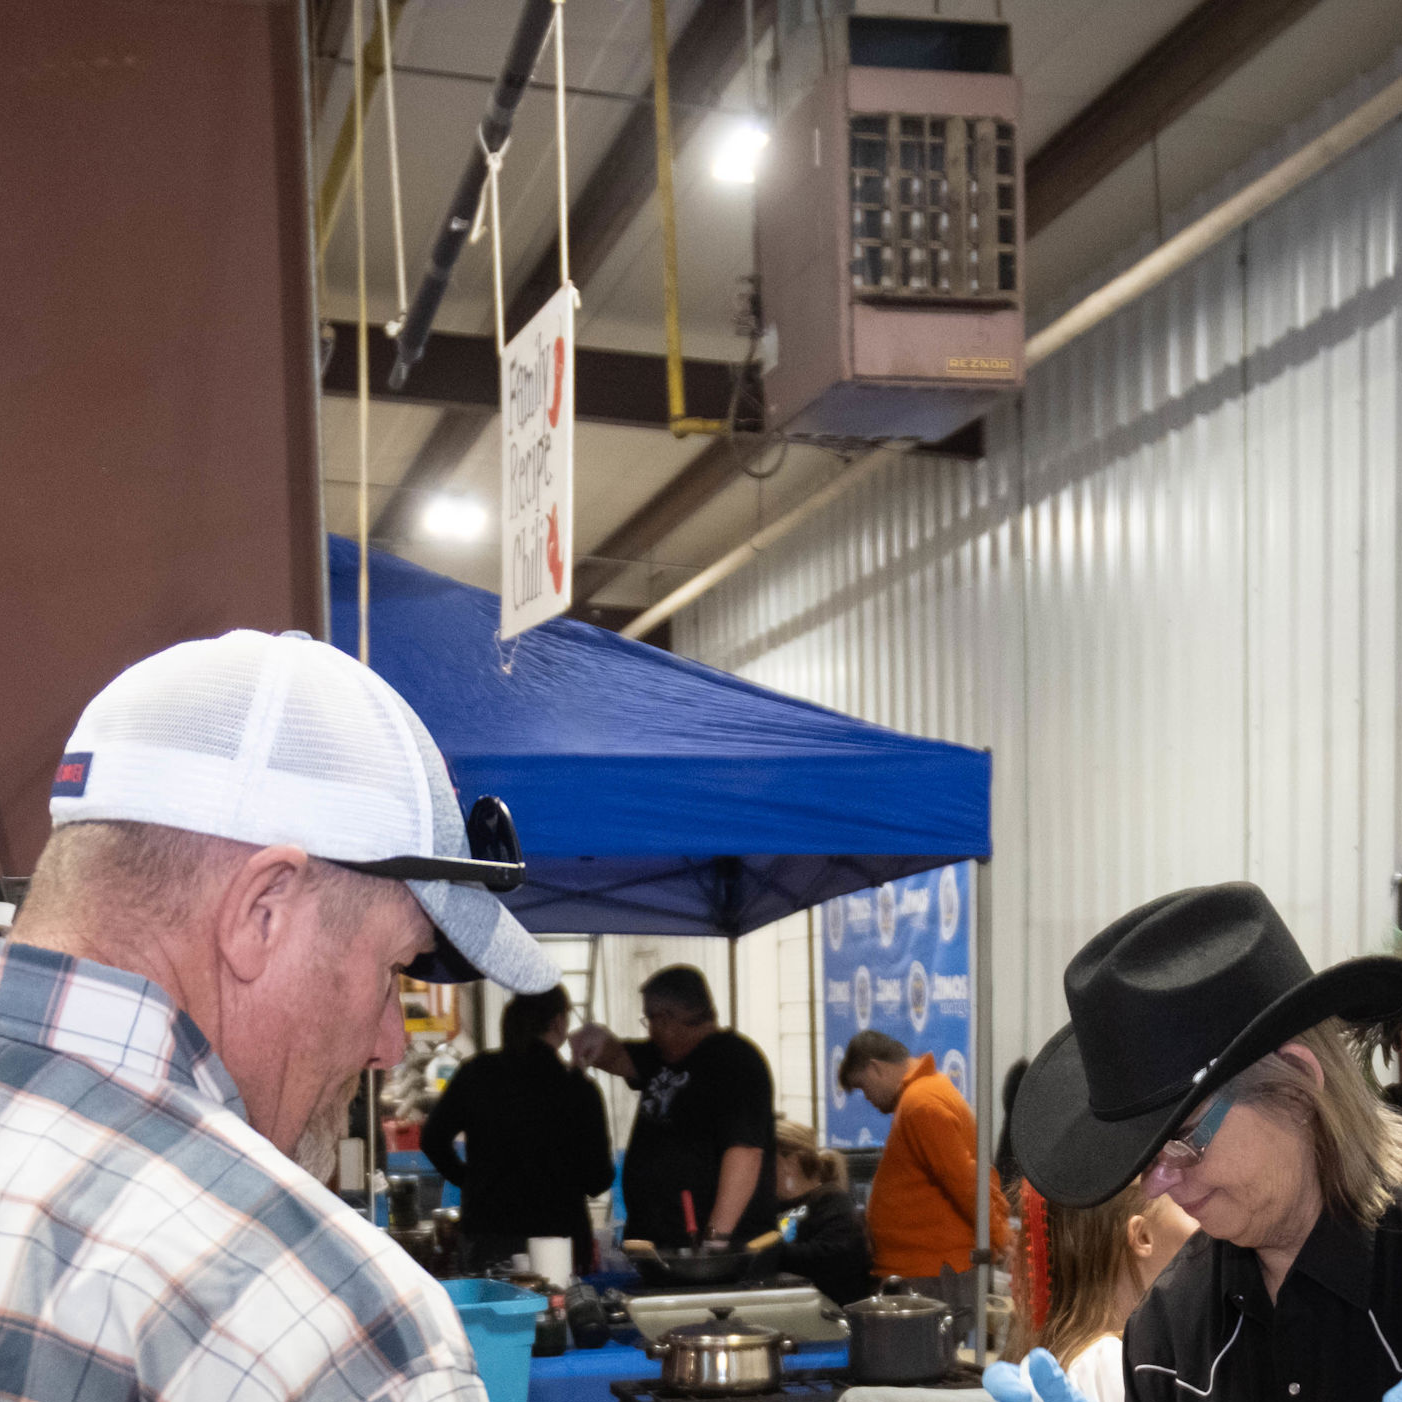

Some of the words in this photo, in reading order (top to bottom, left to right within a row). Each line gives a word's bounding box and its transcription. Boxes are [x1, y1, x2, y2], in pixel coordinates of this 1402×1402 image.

[509, 331, 551, 436] Family
[949, 359, 1010, 369] REZNOR
[509, 432, 553, 519] Recipe
[512, 515, 544, 611] Chili
